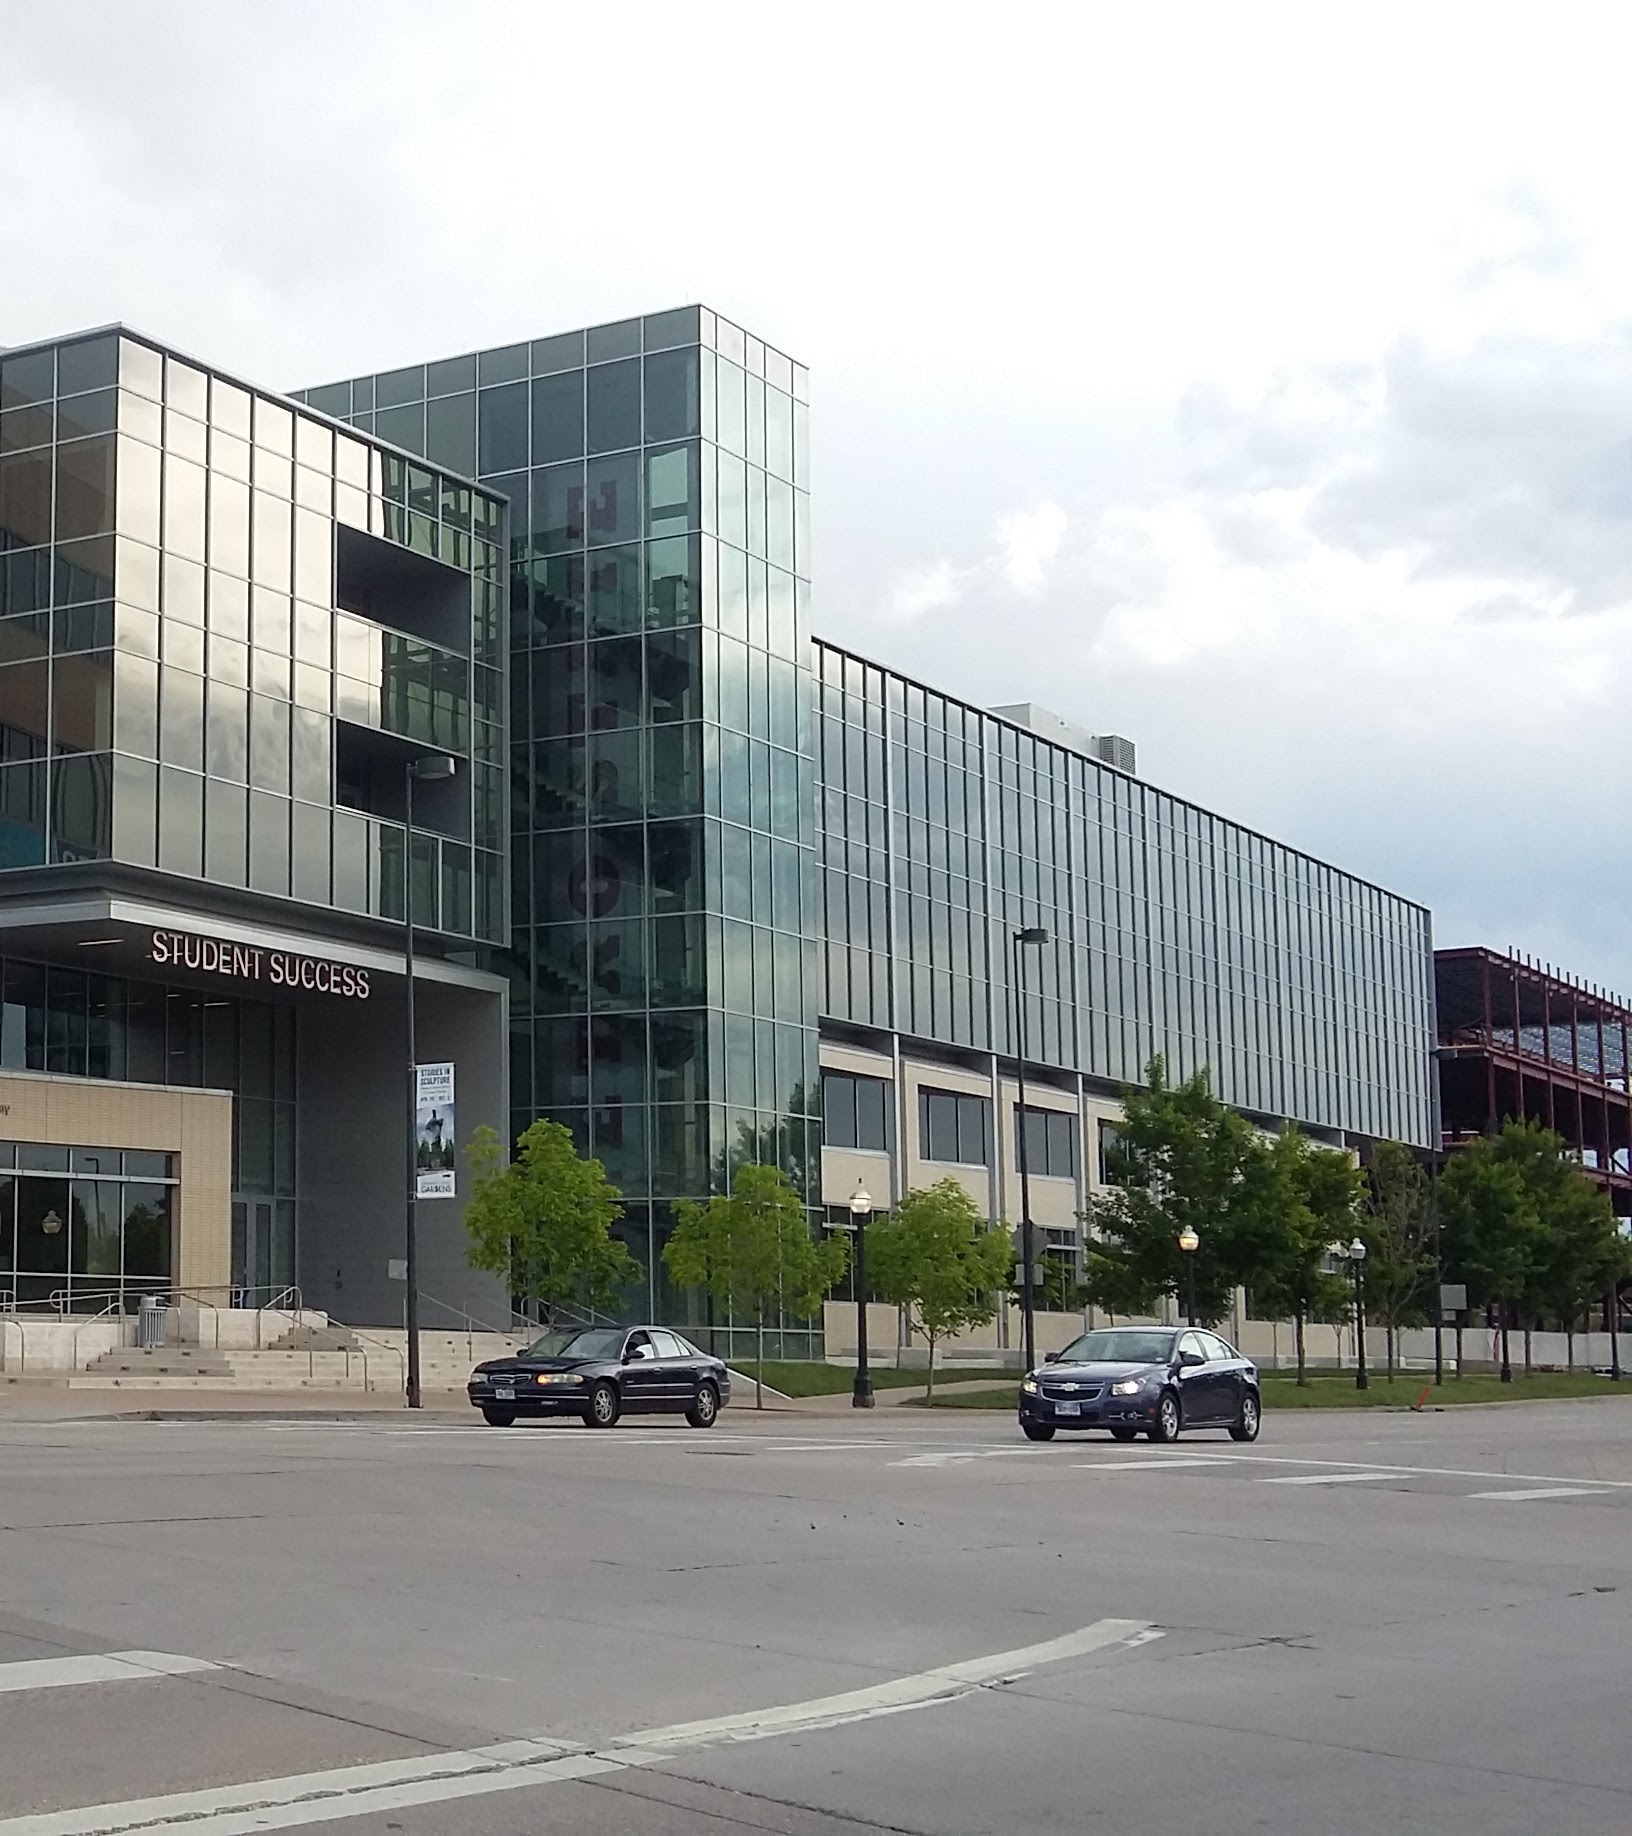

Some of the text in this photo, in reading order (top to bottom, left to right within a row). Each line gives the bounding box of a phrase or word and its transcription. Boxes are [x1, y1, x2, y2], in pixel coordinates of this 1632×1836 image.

[152, 930, 370, 999] STUDENT SUCCESS
[421, 1076, 450, 1085] SCULPTURE
